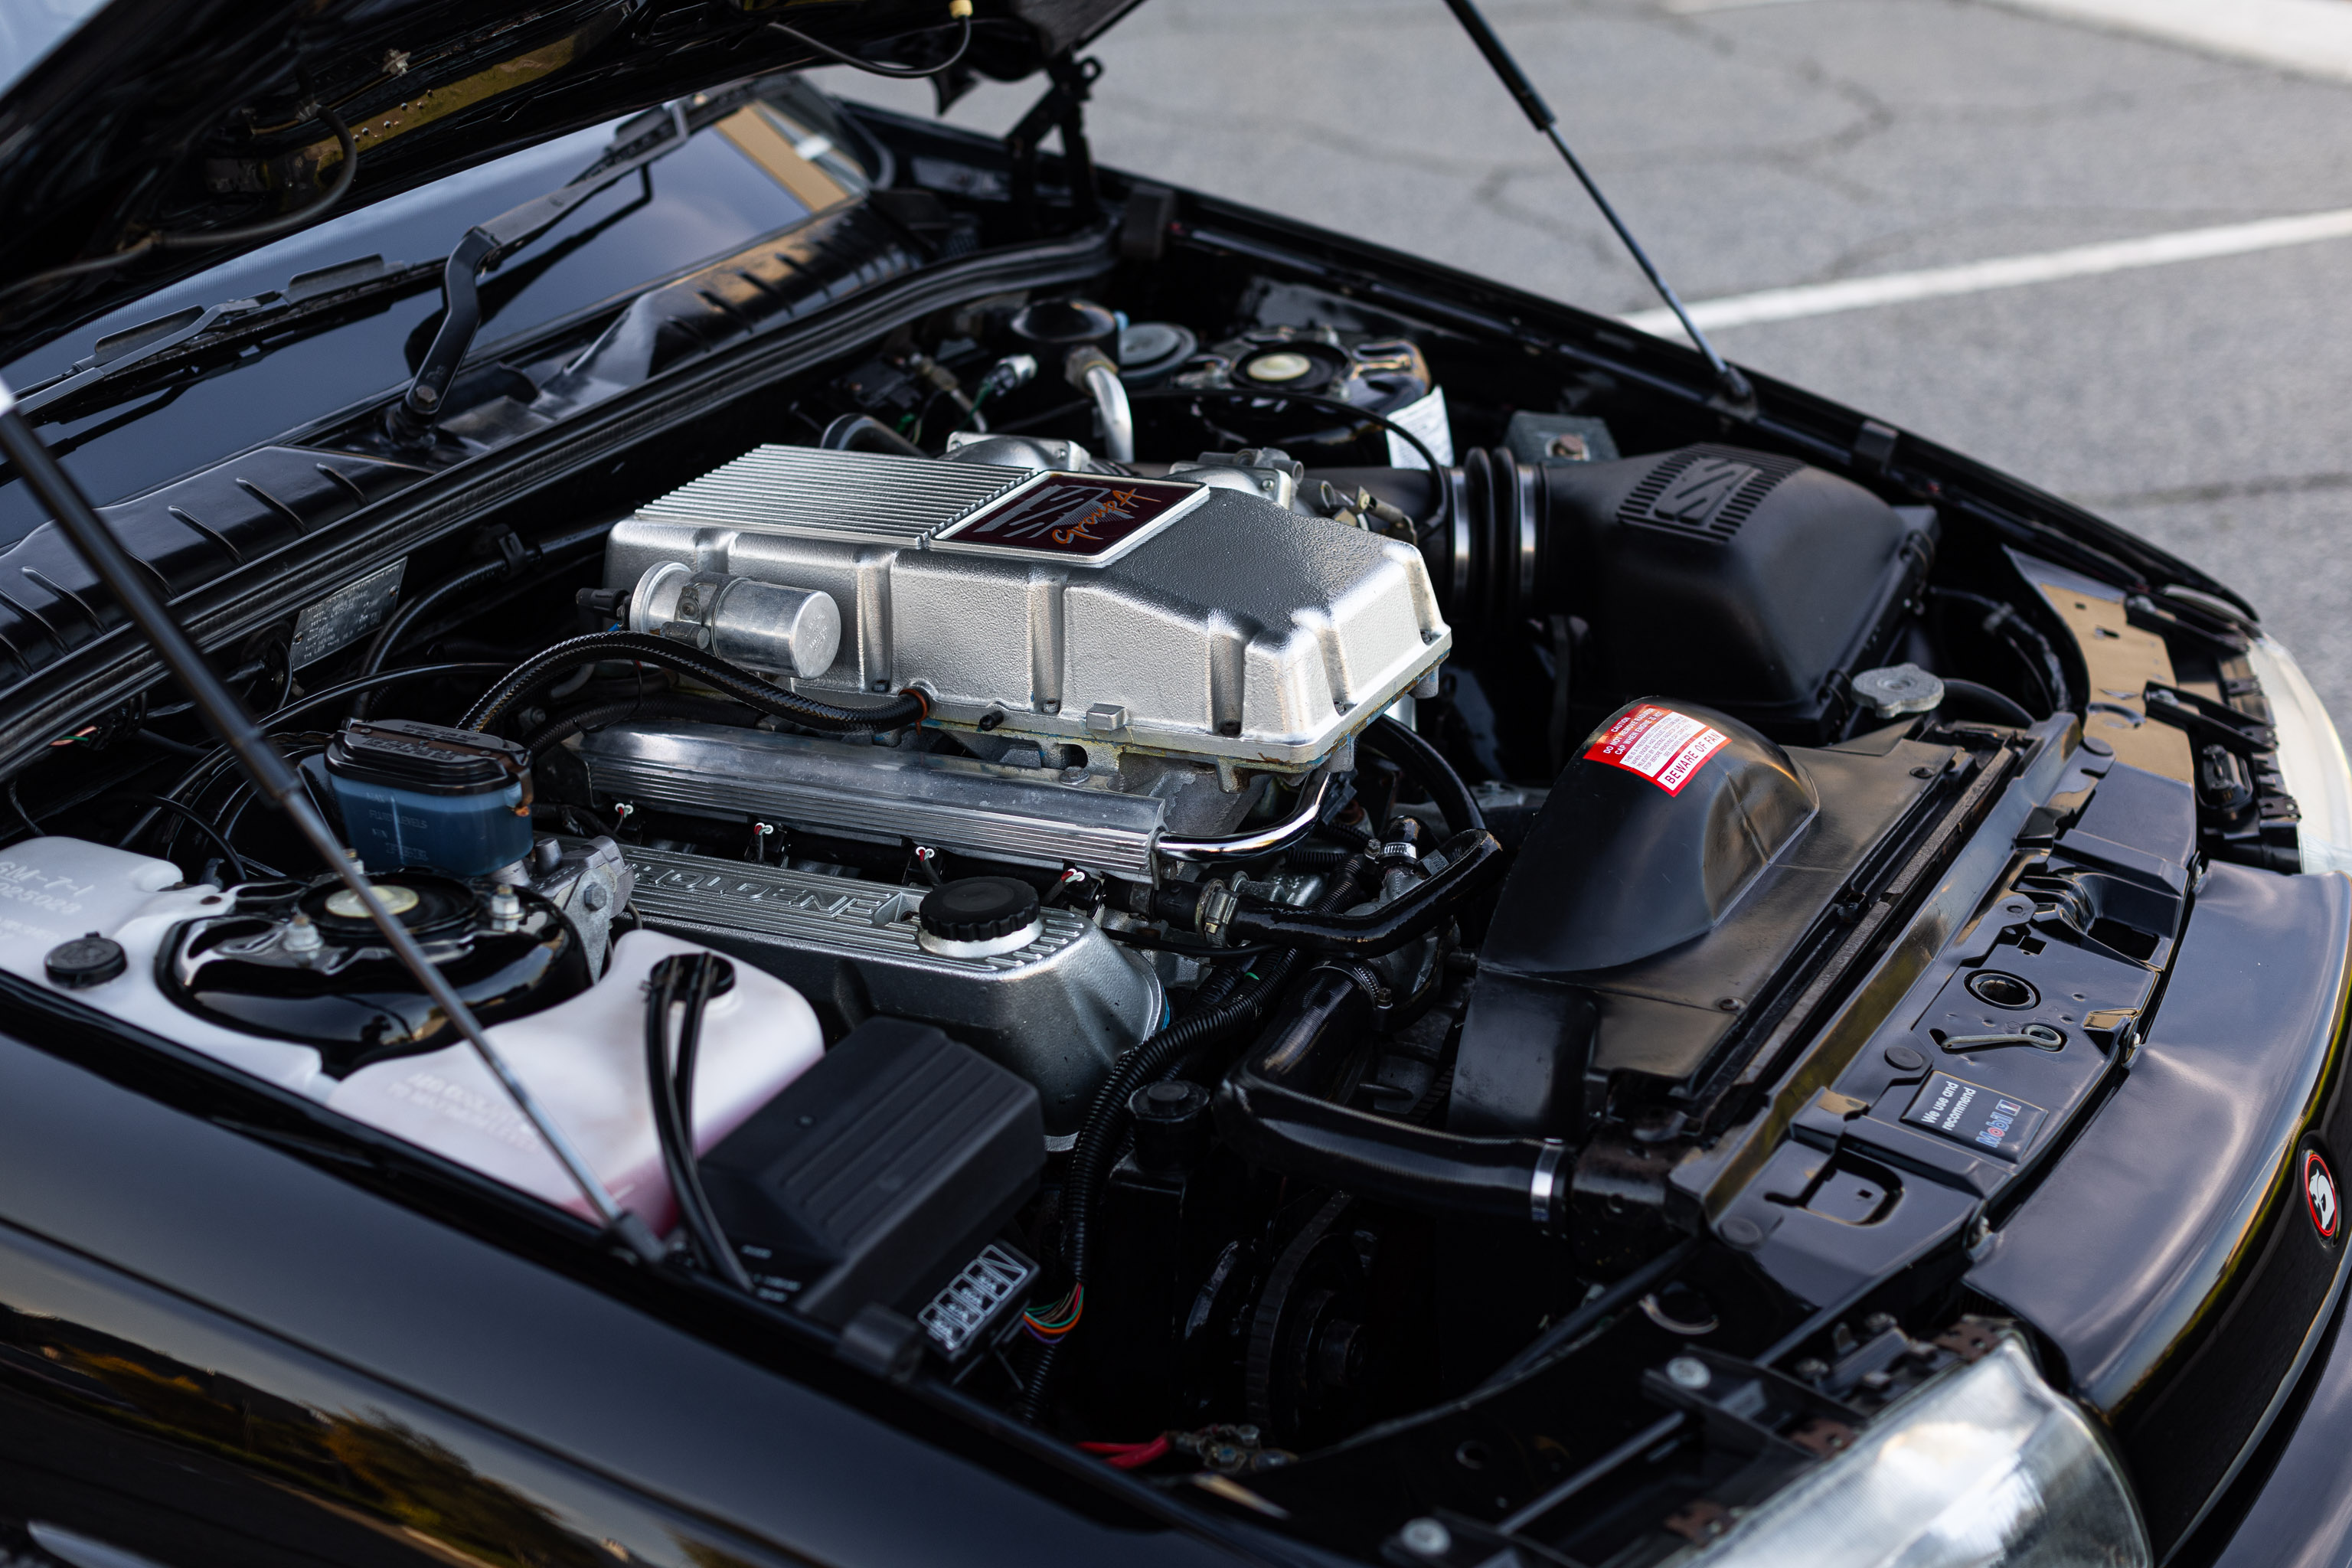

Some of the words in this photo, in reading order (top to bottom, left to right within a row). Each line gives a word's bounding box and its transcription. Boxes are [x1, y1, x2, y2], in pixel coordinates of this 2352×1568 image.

[1603, 746, 1614, 754] DO
[1609, 736, 1622, 746] NOT
[1619, 720, 1638, 736] REMOVE
[1635, 707, 1656, 722] RADIATOR
[1611, 717, 1631, 732] CAUTION
[1614, 744, 1626, 755] CAP
[1623, 732, 1639, 745] WHEN
[1635, 719, 1652, 732] ENGINE
[1642, 761, 1652, 769] STOP
[1664, 750, 1699, 784] BEWARE
[1693, 741, 1709, 752] OF
[1703, 732, 1722, 743] FAN
[626, 863, 858, 918] HOLDEN
[1921, 1109, 1940, 1124] We
[1932, 1096, 1949, 1112] use
[1942, 1081, 1959, 1098] and
[1942, 1086, 1978, 1131] recommend
[1975, 1111, 2014, 1148] Mobil
